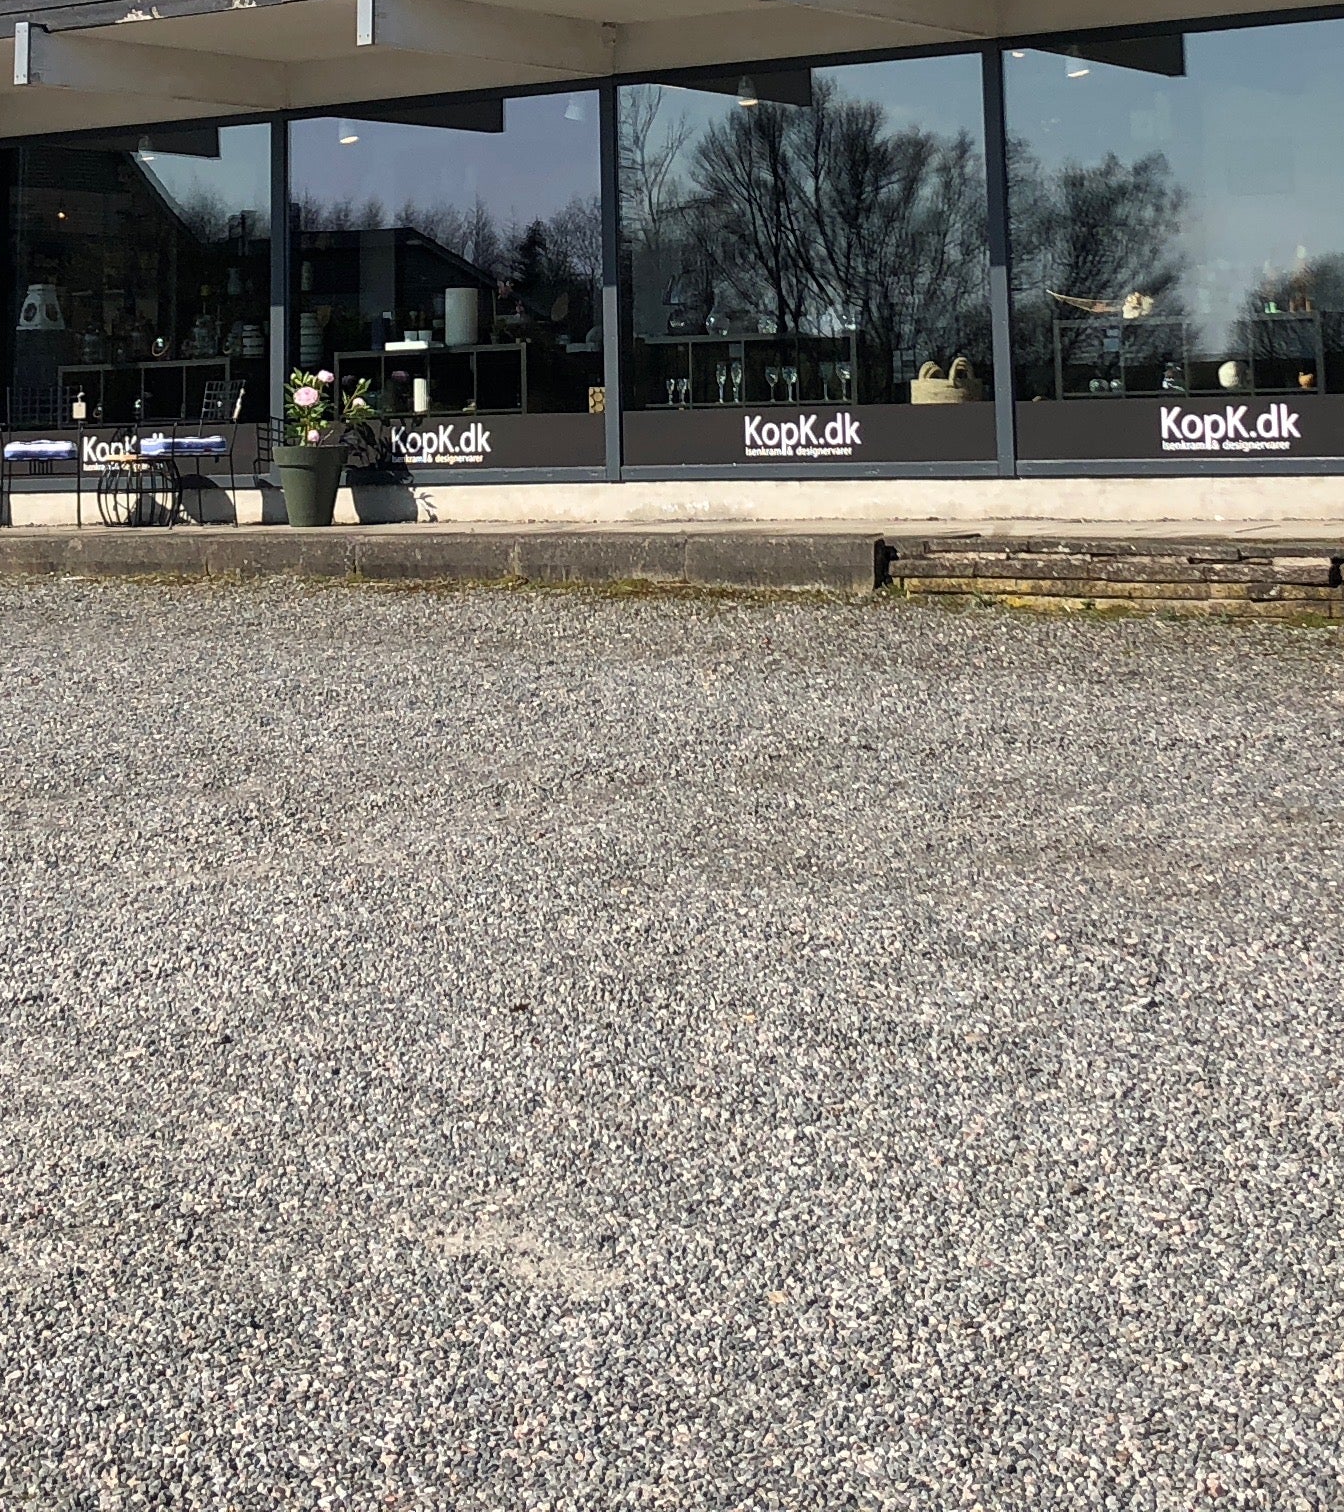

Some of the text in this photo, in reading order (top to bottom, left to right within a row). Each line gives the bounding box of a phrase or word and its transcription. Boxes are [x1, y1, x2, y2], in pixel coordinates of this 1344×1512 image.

[391, 423, 492, 463] KopK.dk
[744, 412, 862, 456] KopK.dk
[1160, 403, 1302, 450] KopK.dk
